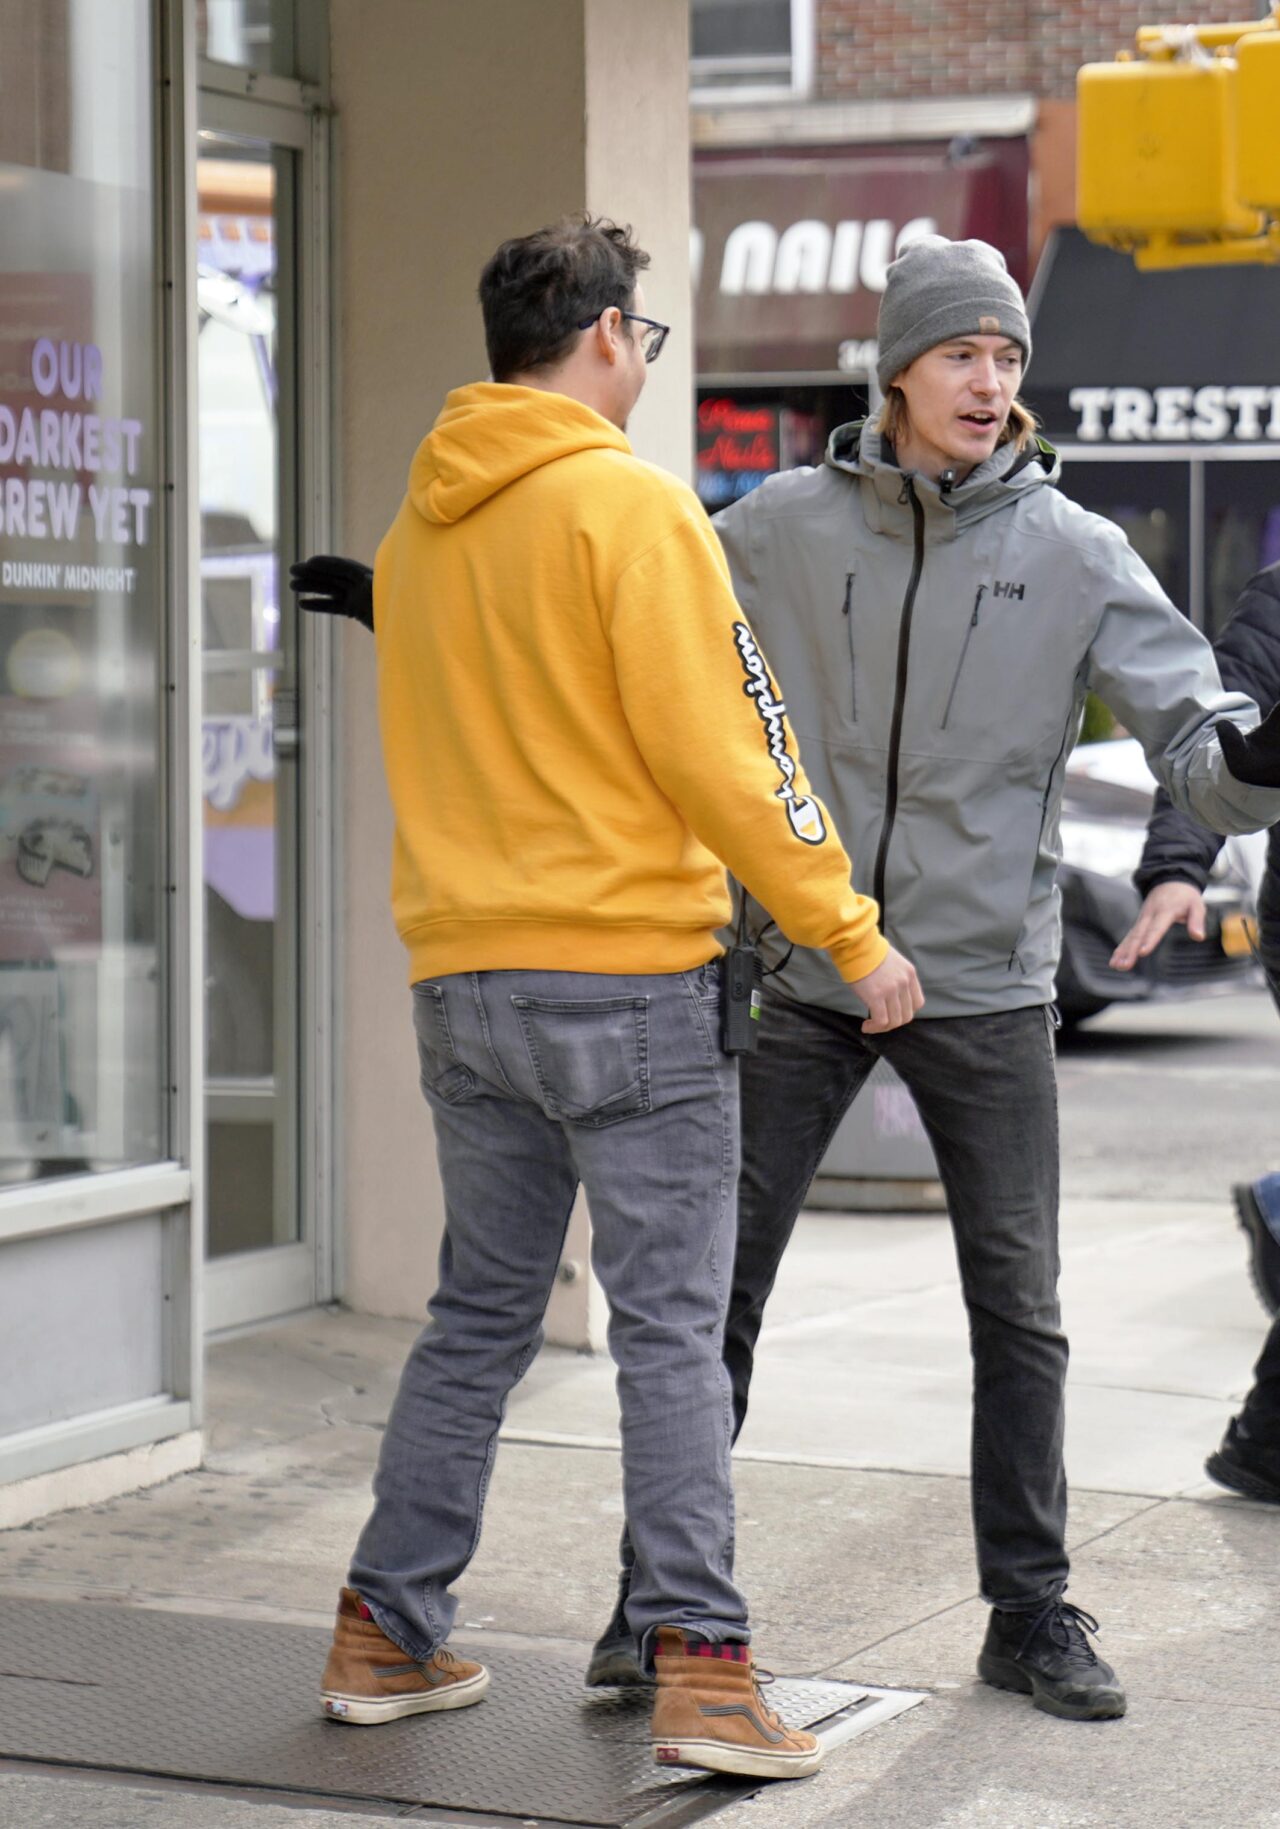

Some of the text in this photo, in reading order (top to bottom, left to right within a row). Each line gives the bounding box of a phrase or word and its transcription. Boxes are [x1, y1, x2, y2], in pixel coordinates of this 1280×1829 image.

[32, 337, 103, 400] OUR
[0, 404, 142, 476] DARKEST
[0, 477, 151, 546] REW YET
[2, 561, 135, 593] DUNKIN' MIDNIGHT
[732, 621, 826, 845] Champion
